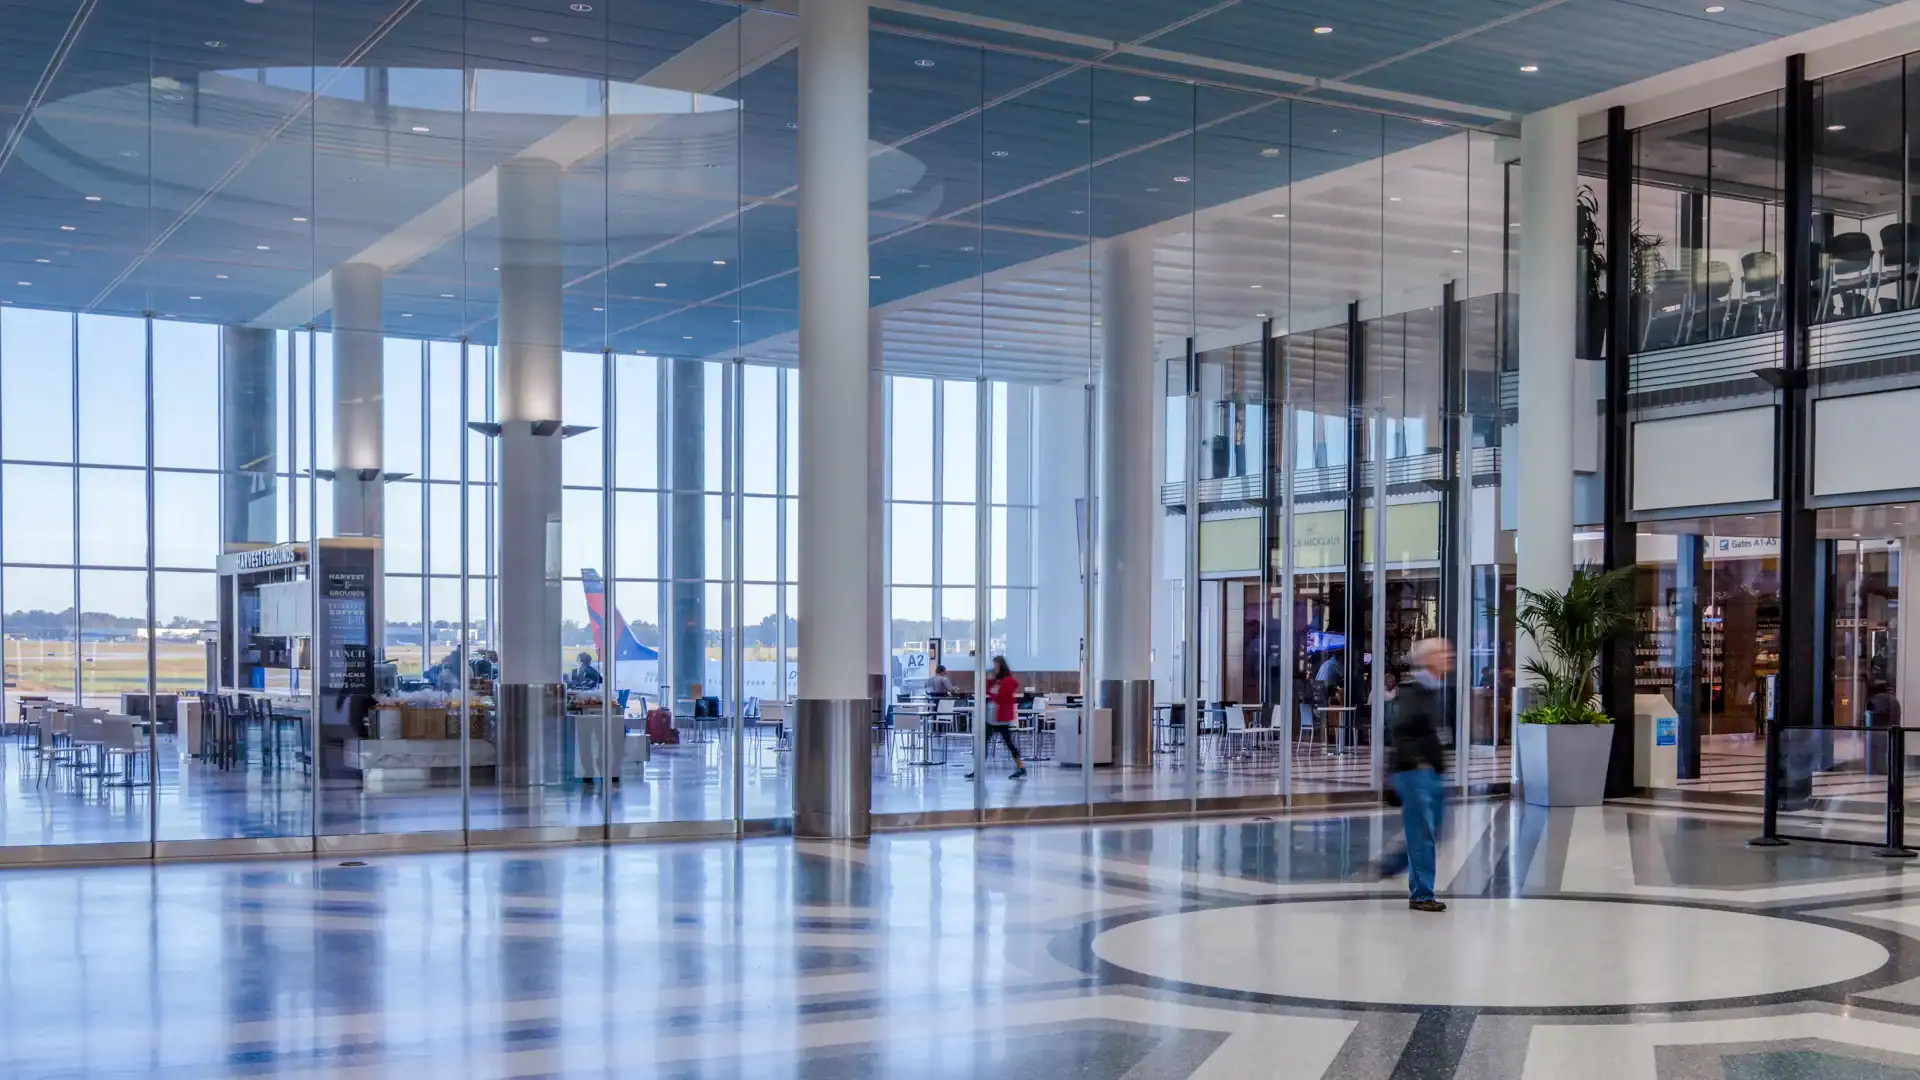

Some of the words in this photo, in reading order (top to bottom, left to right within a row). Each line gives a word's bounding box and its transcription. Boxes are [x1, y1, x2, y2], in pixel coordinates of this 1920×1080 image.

[1732, 539, 1752, 548] Gates
[1754, 537, 1776, 546] A1-A5
[237, 551, 262, 569] HARVEST
[266, 546, 295, 565] GROUNDS
[329, 649, 366, 658] LUNCH
[907, 654, 925, 668] A2
